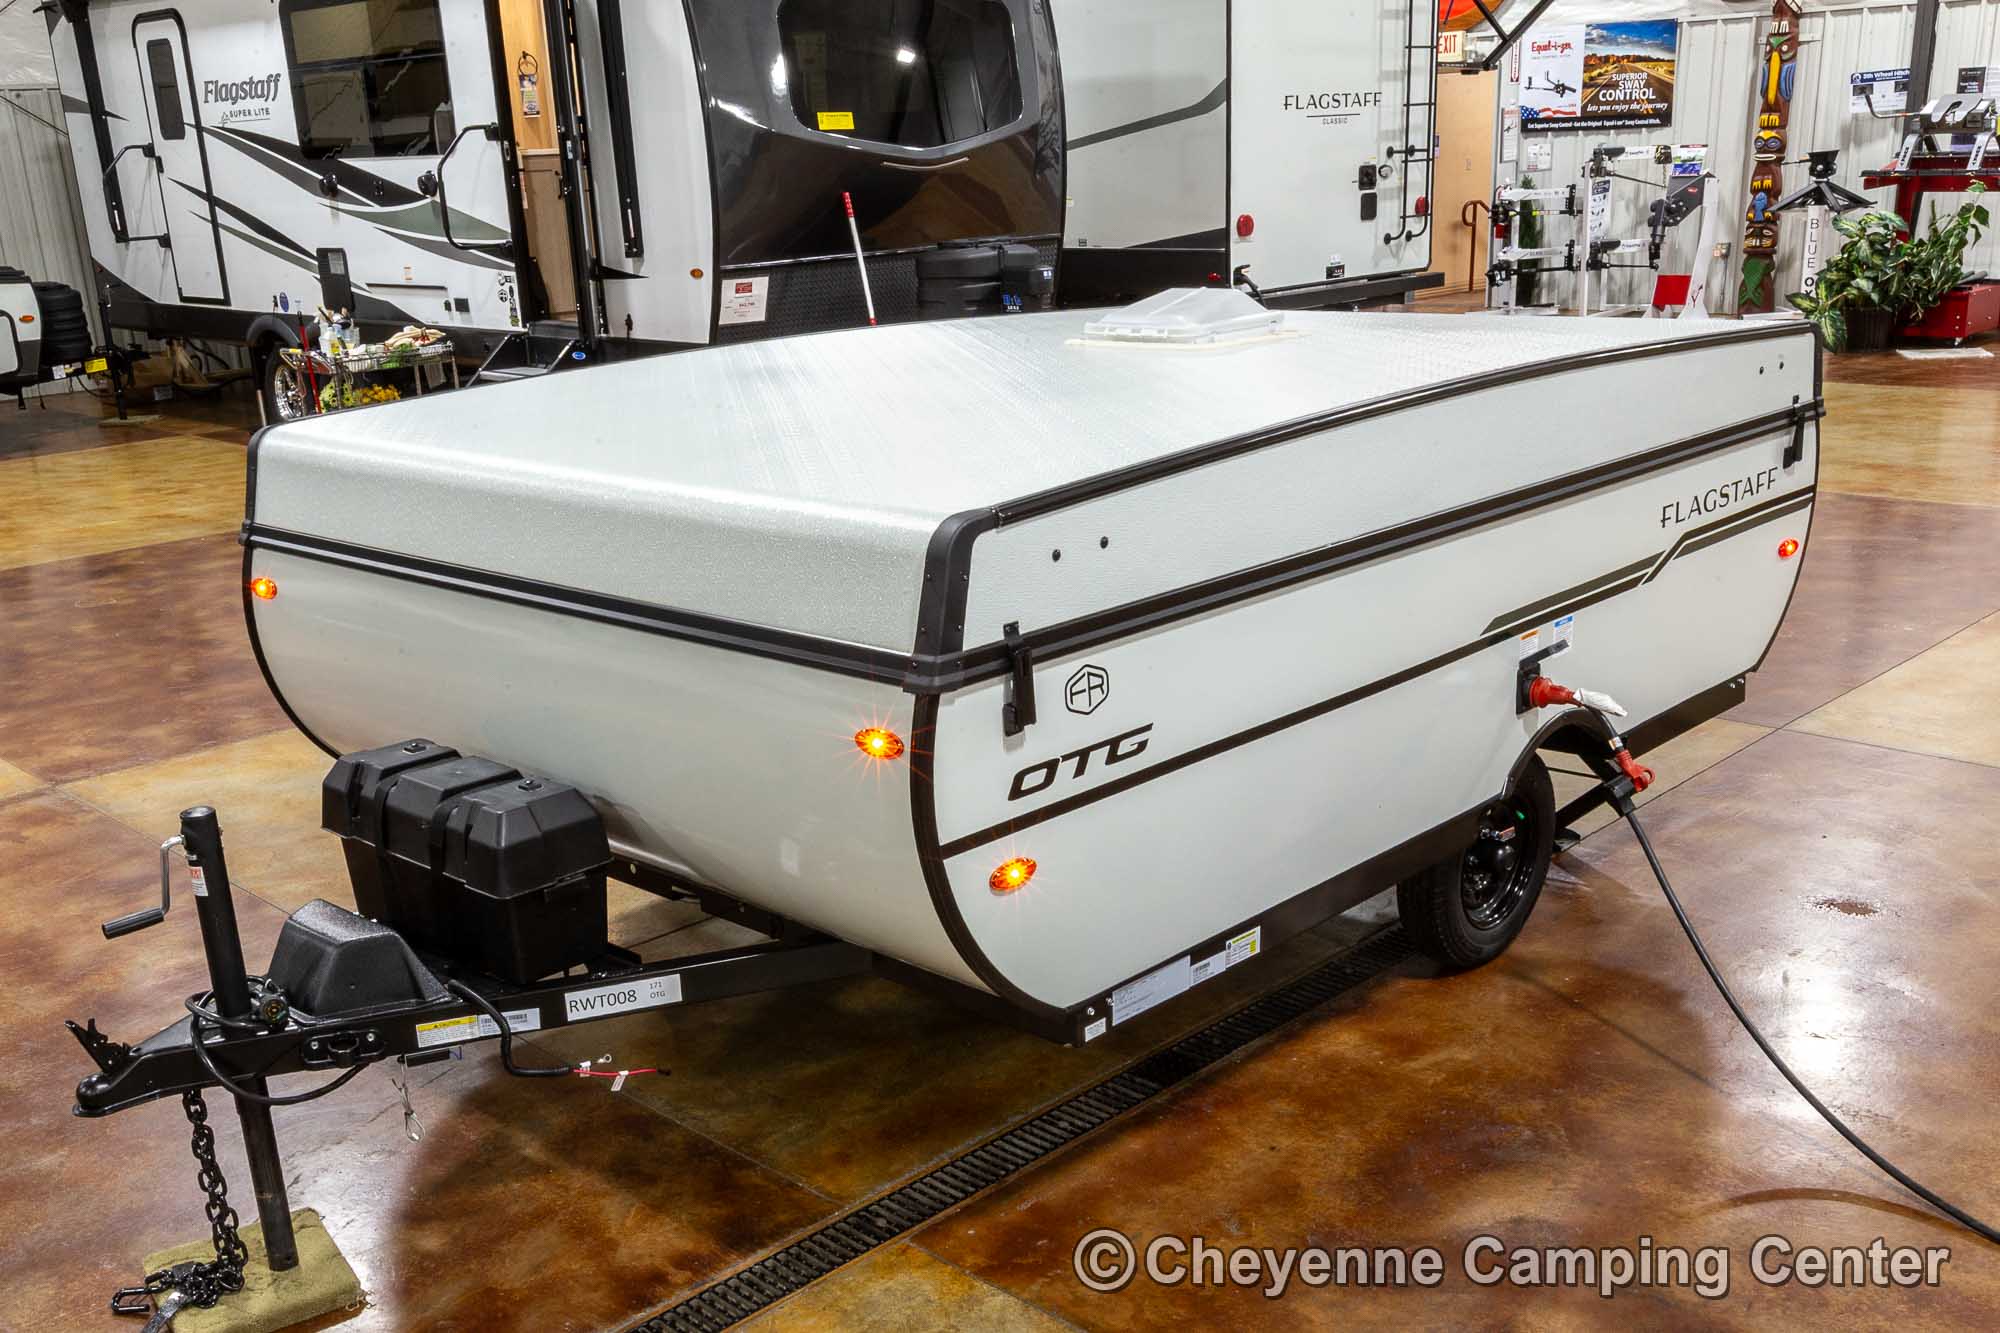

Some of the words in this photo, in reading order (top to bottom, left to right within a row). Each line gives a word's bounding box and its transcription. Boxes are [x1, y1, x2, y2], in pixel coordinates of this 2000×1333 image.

[1437, 34, 1457, 54] EXIT
[1612, 72, 1648, 81] SUPERIOR
[203, 73, 281, 105] Flagstaff
[1618, 80, 1646, 90] SWAY
[1283, 92, 1383, 110] FLAGSTAFF
[1599, 88, 1656, 102] CONTROL
[229, 108, 252, 118] SUPER
[254, 107, 271, 116] LITE
[1599, 105, 1611, 113] you
[1612, 103, 1630, 112] enjoy
[1630, 101, 1641, 110] the
[1640, 103, 1668, 111] journey
[1322, 117, 1348, 125] CLASSIC
[1807, 218, 1820, 269] BLUE
[1660, 467, 1778, 528] FLAGSTAFF
[1008, 722, 1154, 802] OTG
[649, 981, 662, 990] 171
[568, 989, 637, 1013] RWT008
[649, 991, 666, 999] OTG
